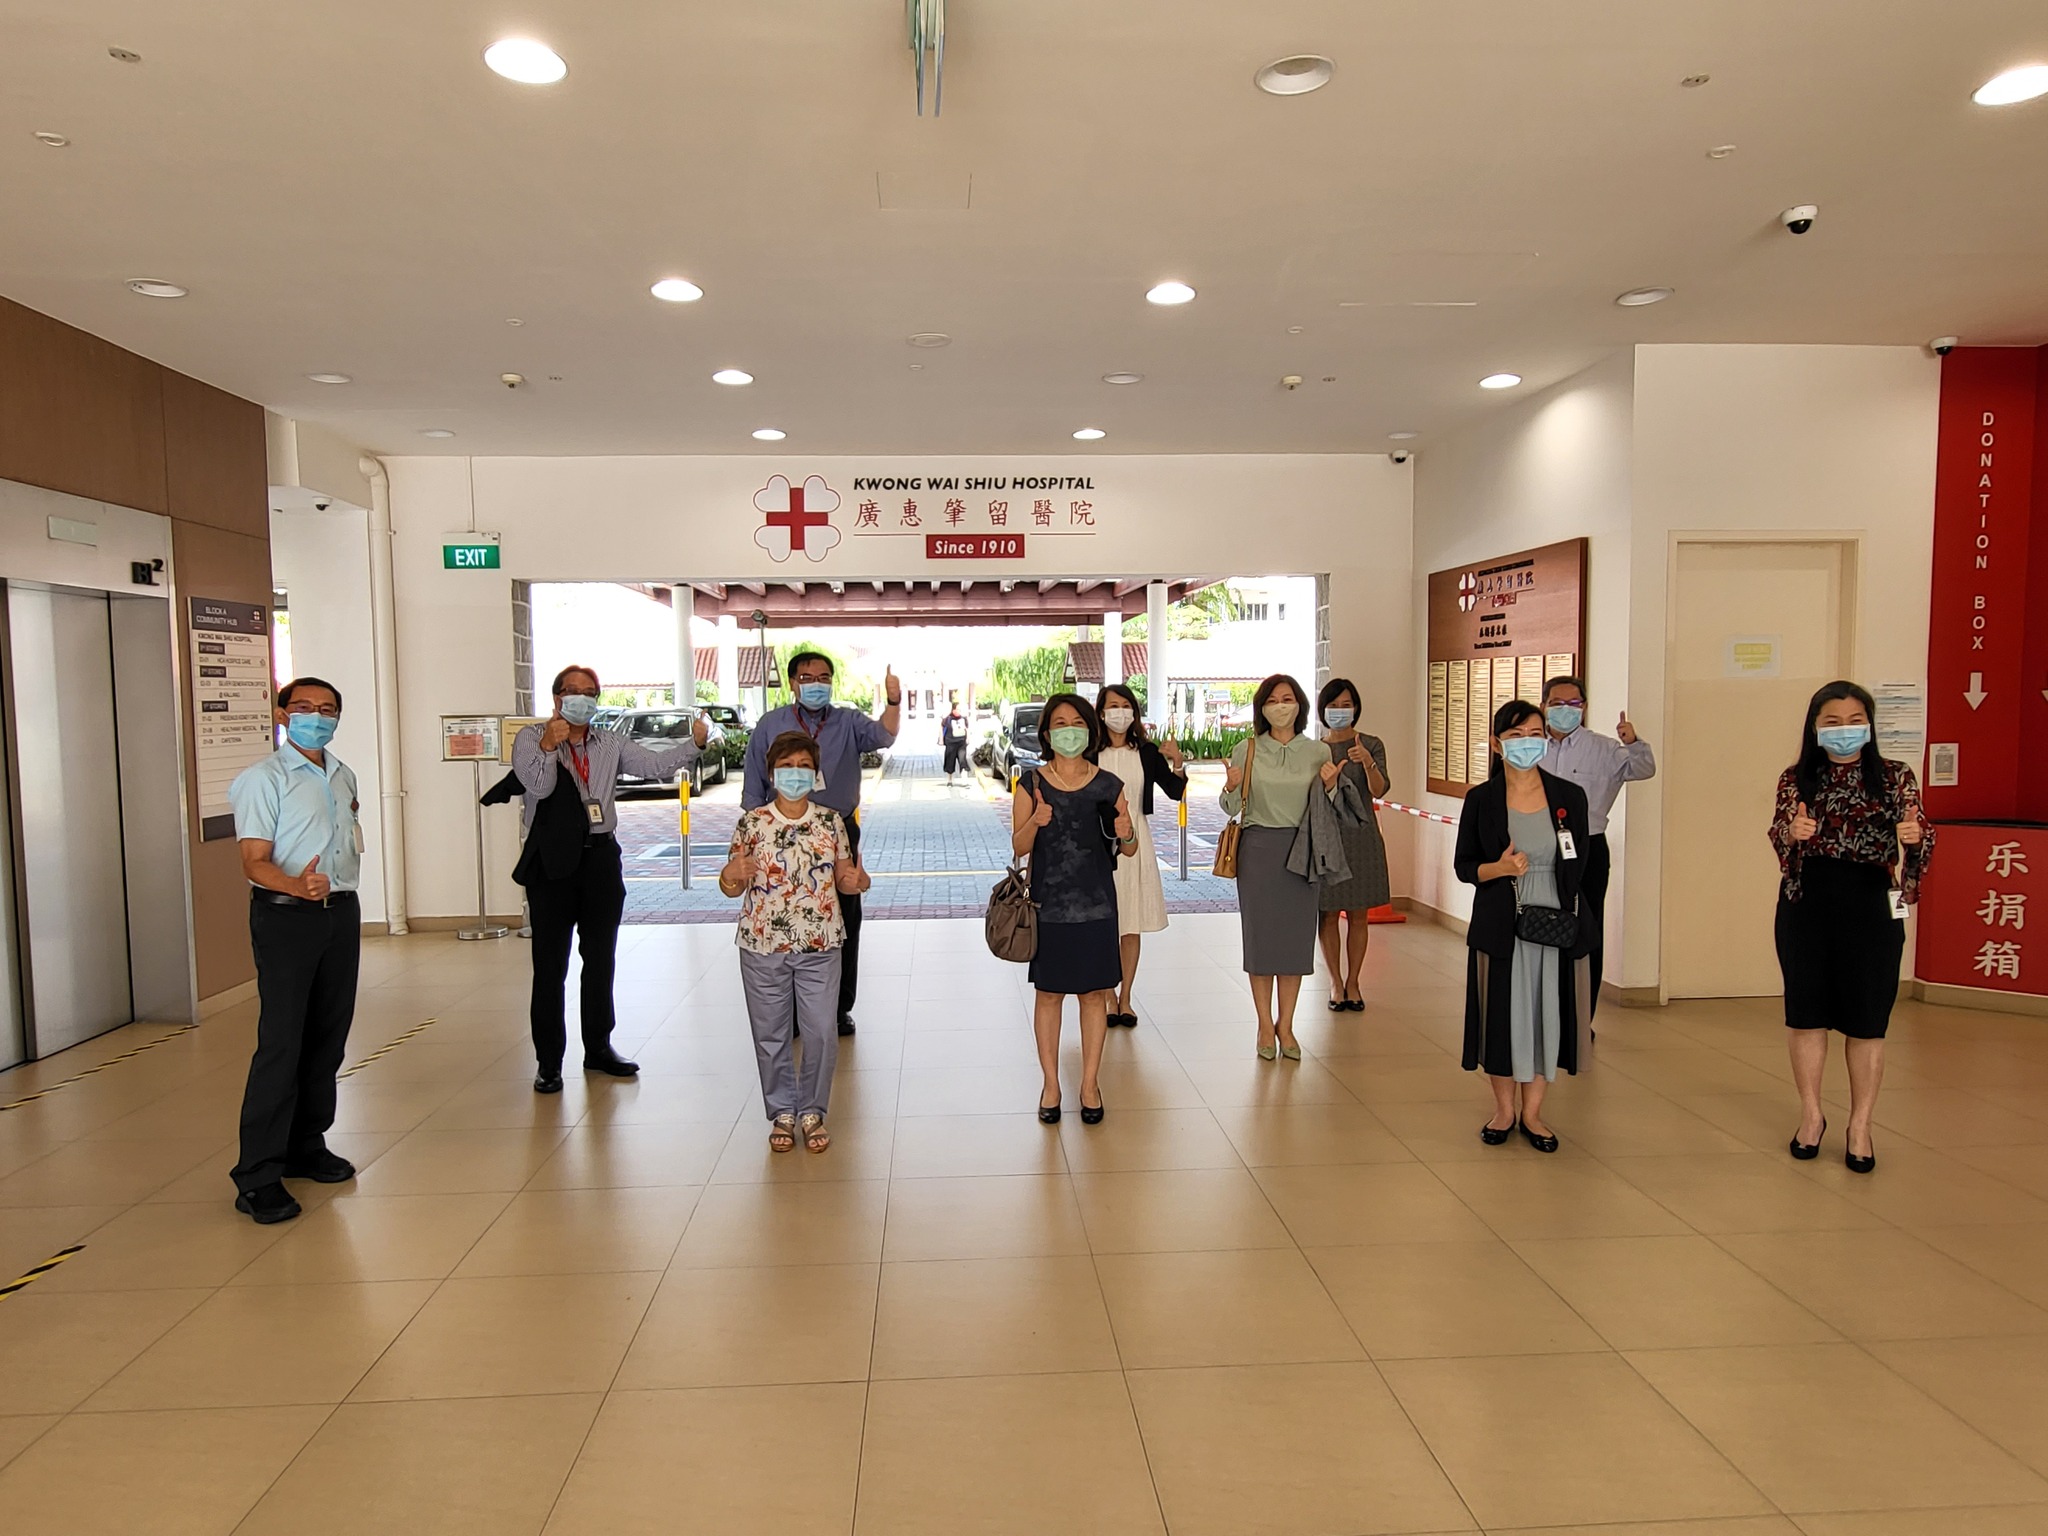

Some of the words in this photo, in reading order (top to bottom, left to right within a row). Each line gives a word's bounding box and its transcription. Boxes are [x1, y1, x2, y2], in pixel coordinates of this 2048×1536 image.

[853, 477, 922, 491] KWONG
[926, 477, 959, 491] WAI
[964, 477, 1007, 490] SHIU
[1012, 476, 1095, 490] HOSPITAL
[1975, 412, 1995, 569] DONATION
[853, 498, 1096, 528] 廣惠肇留醫院
[454, 548, 488, 566] EXIT
[934, 540, 975, 555] Since
[981, 540, 1017, 554] 1910
[1972, 595, 1986, 650] BOX
[1973, 841, 2029, 980] 乐捐箱
